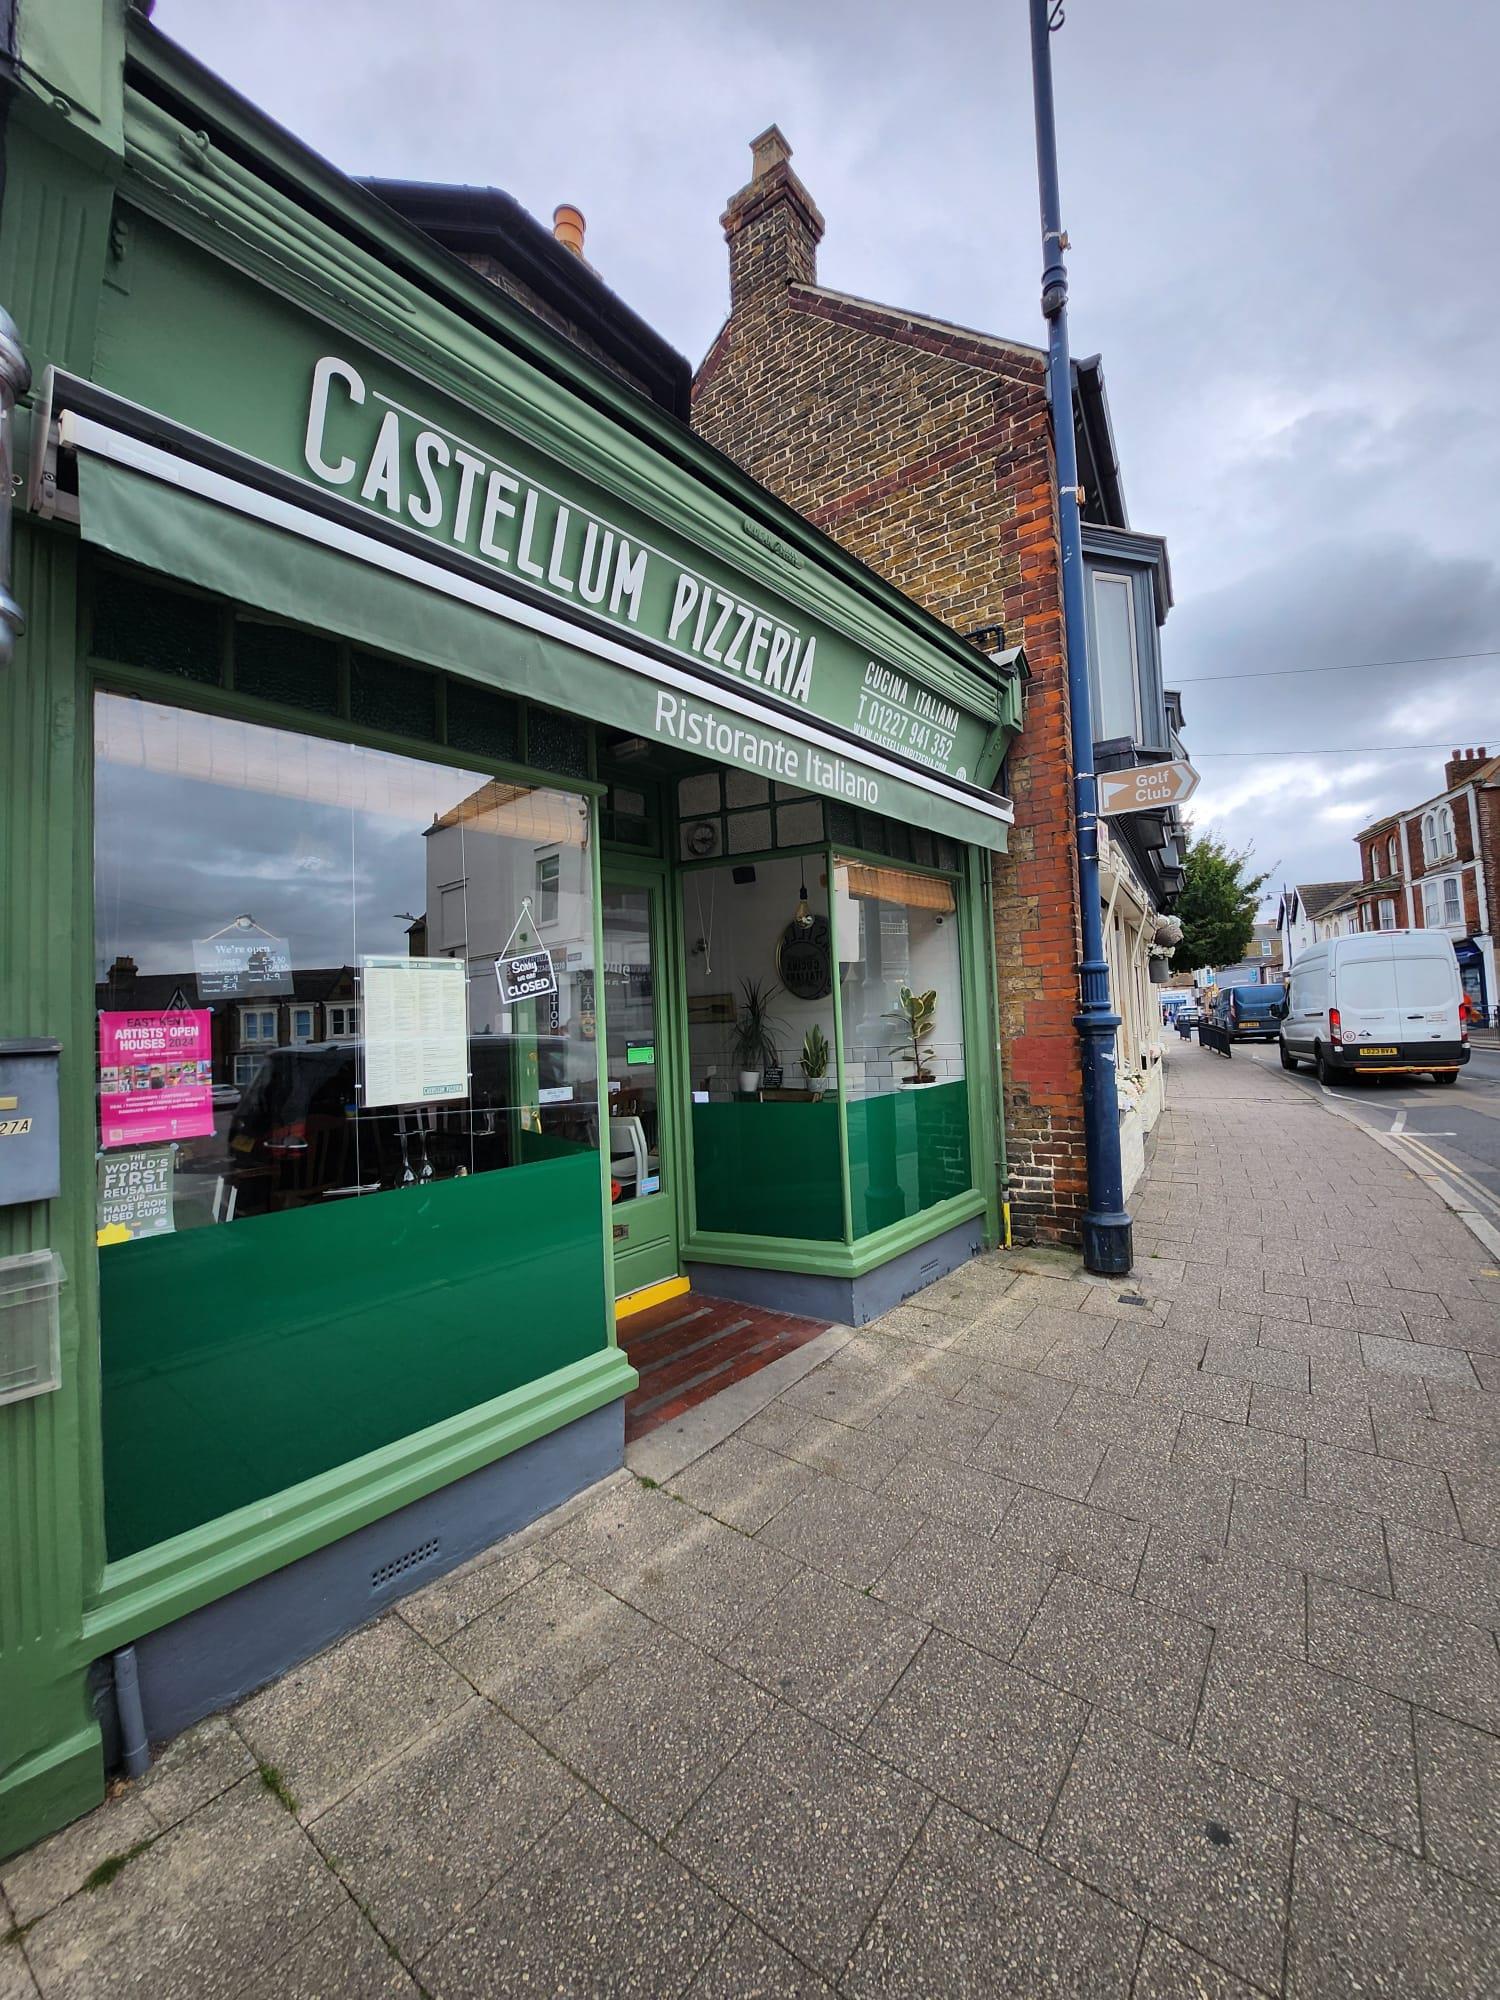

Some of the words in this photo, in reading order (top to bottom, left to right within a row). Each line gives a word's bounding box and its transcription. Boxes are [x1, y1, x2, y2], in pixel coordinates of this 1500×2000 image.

[305, 357, 648, 622] CASTELLUM
[668, 574, 816, 703] PIZZERIA
[865, 661, 909, 705] CUCINA
[914, 690, 960, 732] ITALIANA
[858, 694, 867, 719] T
[868, 701, 908, 738] 01227
[909, 722, 931, 751] 941
[931, 733, 953, 761] 352
[655, 691, 799, 778] Ristorante
[806, 749, 878, 804] Italiano
[1136, 770, 1169, 787] Golf
[1135, 786, 1171, 802] Club
[216, 945, 245, 953] We're
[247, 946, 270, 954] open
[512, 961, 538, 973] Sorry
[508, 978, 549, 996] CLOSED
[127, 1018, 154, 1027] EAST
[160, 1016, 187, 1026] KENT
[115, 1028, 167, 1039] ARTISTS'
[170, 1026, 199, 1037] OPEN
[120, 1038, 166, 1050] HOUSES
[169, 1038, 194, 1047] 2024
[0, 1120, 29, 1134] 27A
[129, 1153, 147, 1161] THE
[105, 1158, 168, 1174] WORLD'S
[105, 1168, 167, 1188] FIRST
[104, 1182, 167, 1198] REUSABLE
[126, 1194, 145, 1202] CUP
[104, 1202, 134, 1214] MADE
[137, 1198, 167, 1209] FROM
[104, 1211, 133, 1222] USED
[137, 1206, 167, 1217] CUPS
